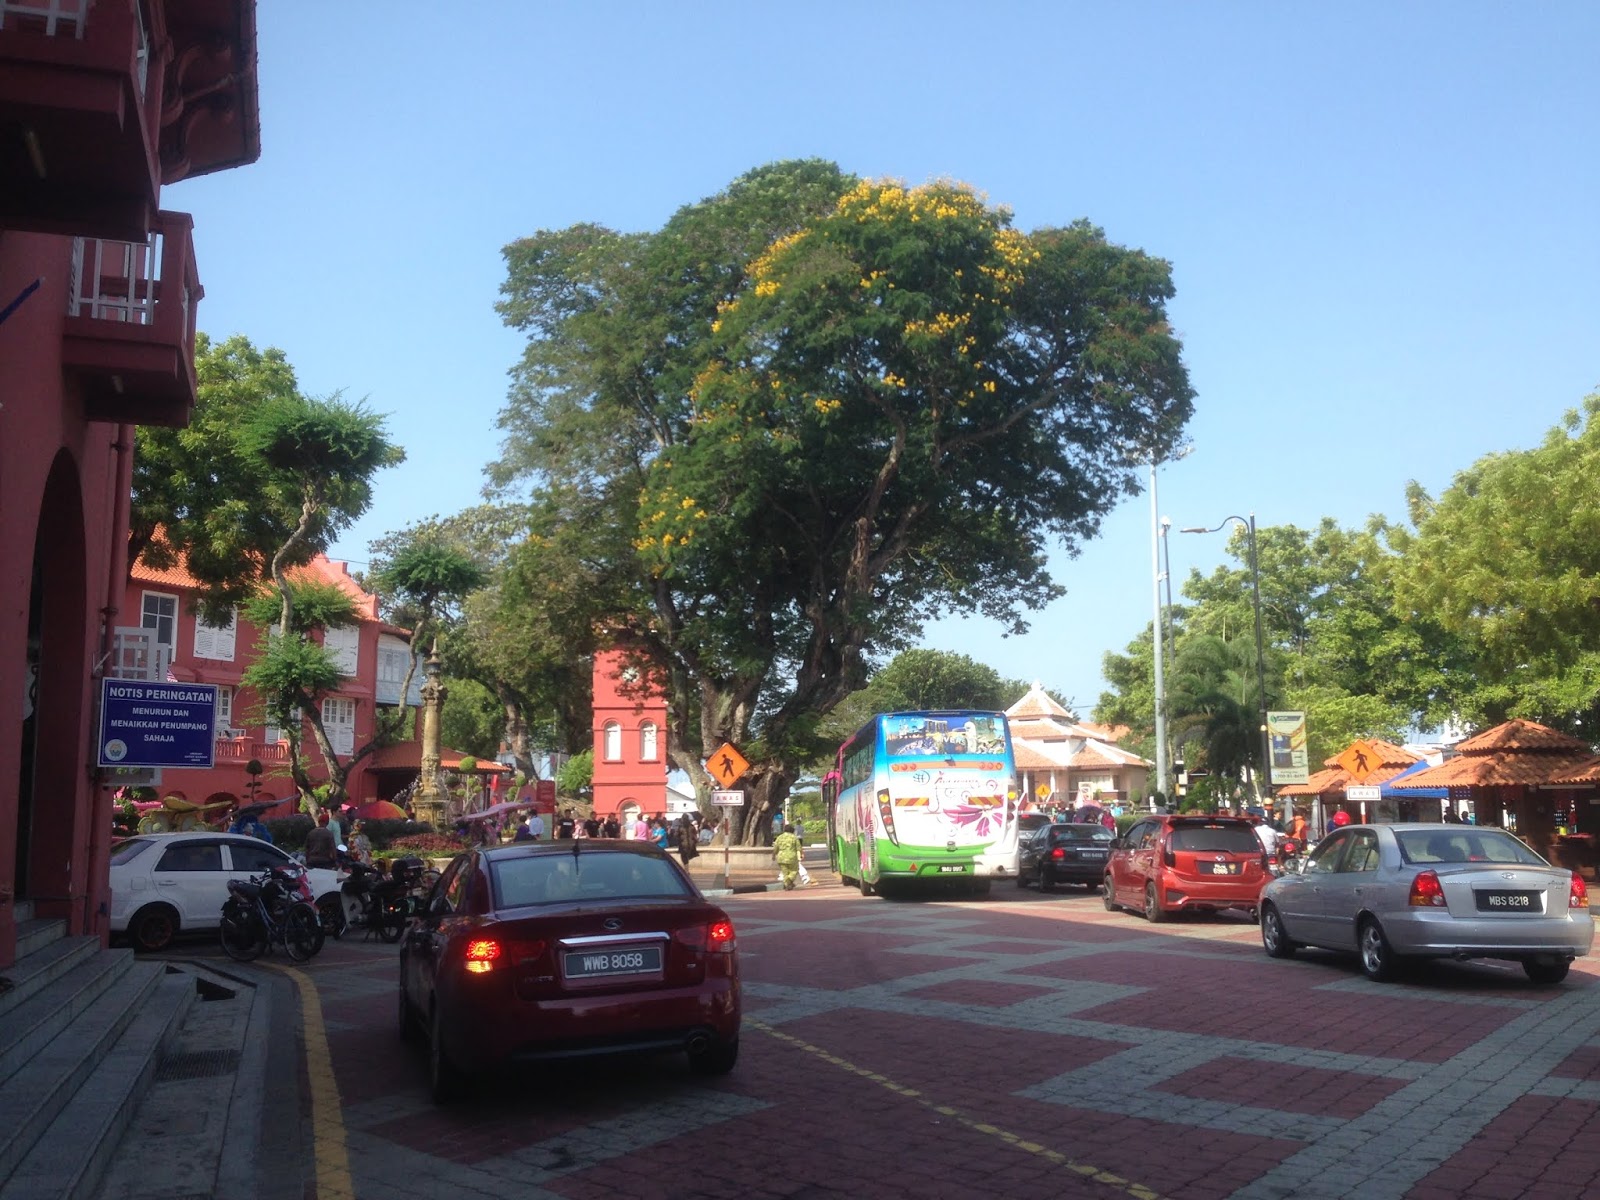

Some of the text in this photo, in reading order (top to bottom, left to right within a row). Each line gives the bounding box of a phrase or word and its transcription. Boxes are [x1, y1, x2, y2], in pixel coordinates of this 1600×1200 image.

[109, 687, 212, 703] NOTIS PERINGATAN
[132, 707, 189, 717] MENURUN DAN
[110, 720, 208, 731] MENAIKKAN PENUMPANG
[144, 734, 175, 742] SAHAJA
[1489, 895, 1529, 906] MBS 8218
[583, 953, 643, 971] WWB 8058
